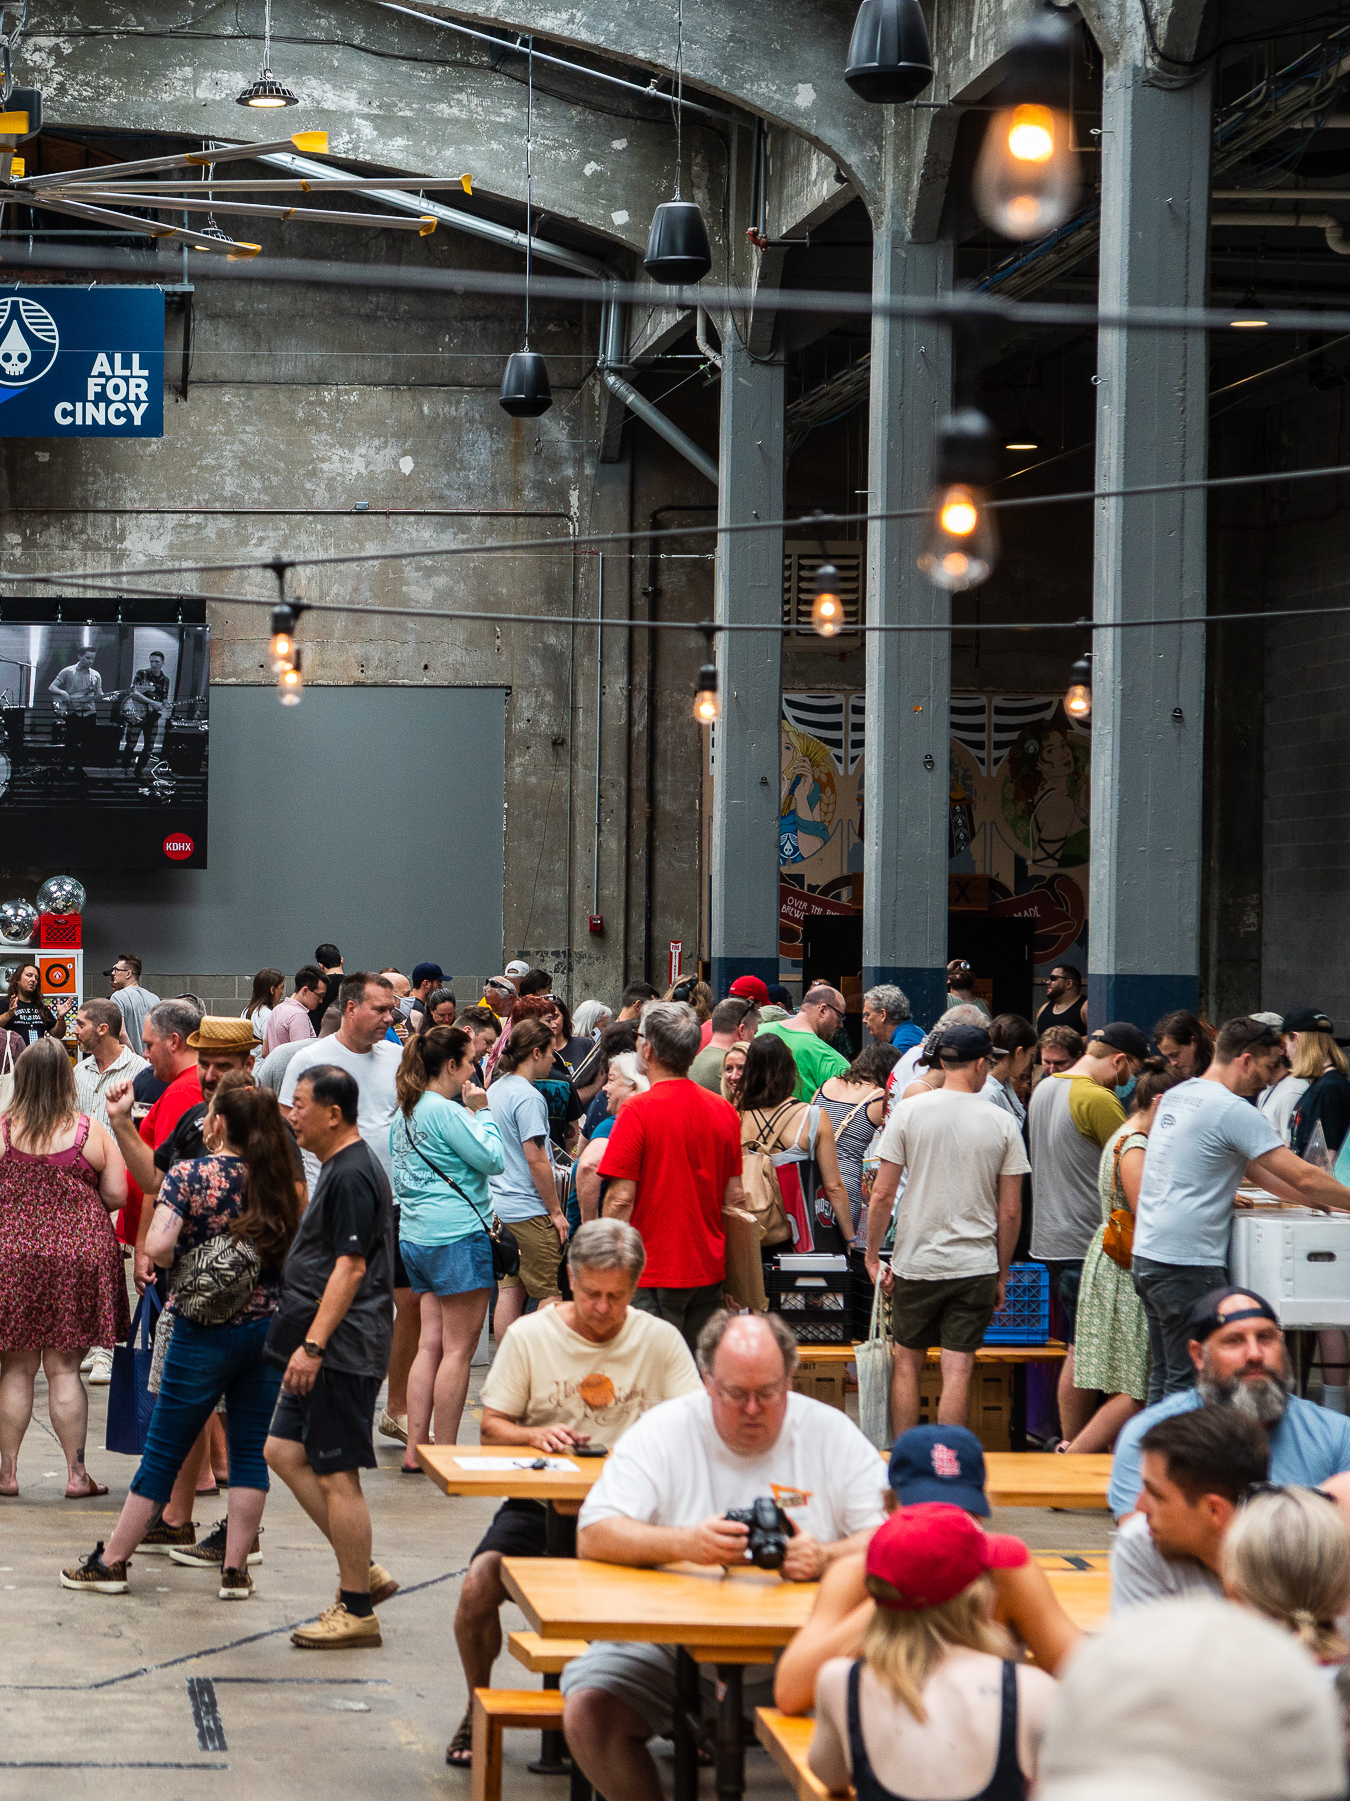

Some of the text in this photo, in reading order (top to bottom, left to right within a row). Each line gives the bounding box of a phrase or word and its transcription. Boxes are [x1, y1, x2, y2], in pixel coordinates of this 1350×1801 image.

[91, 353, 149, 376] ALL
[87, 378, 149, 401] FOR
[54, 402, 149, 426] CINCY
[165, 842, 192, 851] KDHX
[787, 896, 808, 910] OVER
[811, 904, 823, 915] THE
